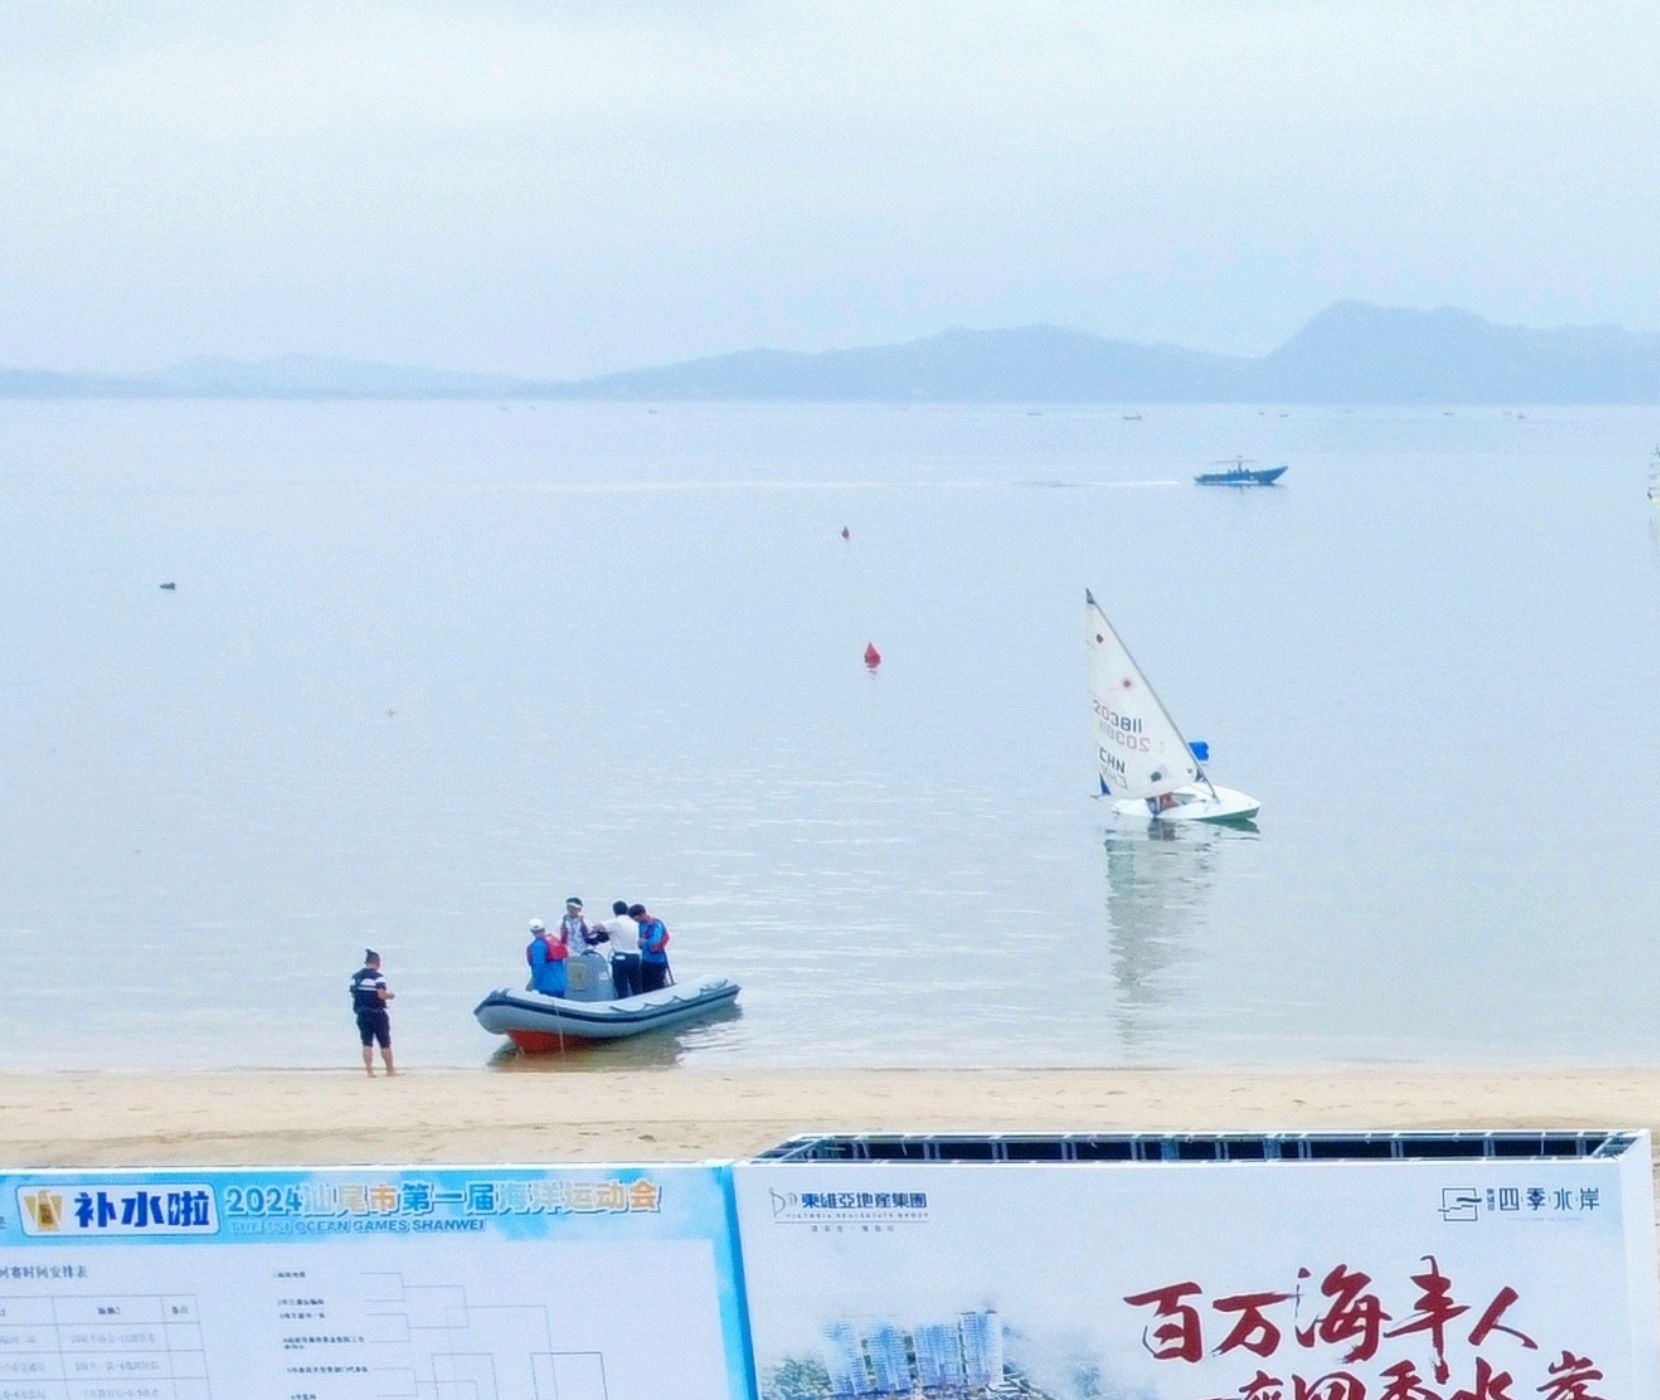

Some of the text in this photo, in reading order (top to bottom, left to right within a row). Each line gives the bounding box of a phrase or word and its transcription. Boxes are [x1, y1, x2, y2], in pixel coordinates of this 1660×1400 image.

[1099, 747, 1126, 774] CHN
[74, 1191, 210, 1228] 补水啦
[295, 1220, 348, 1233] OCEAN
[353, 1219, 409, 1232] GAMES
[413, 1218, 485, 1232] SHANWEI
[1123, 1255, 1539, 1385] 百万海丰人
